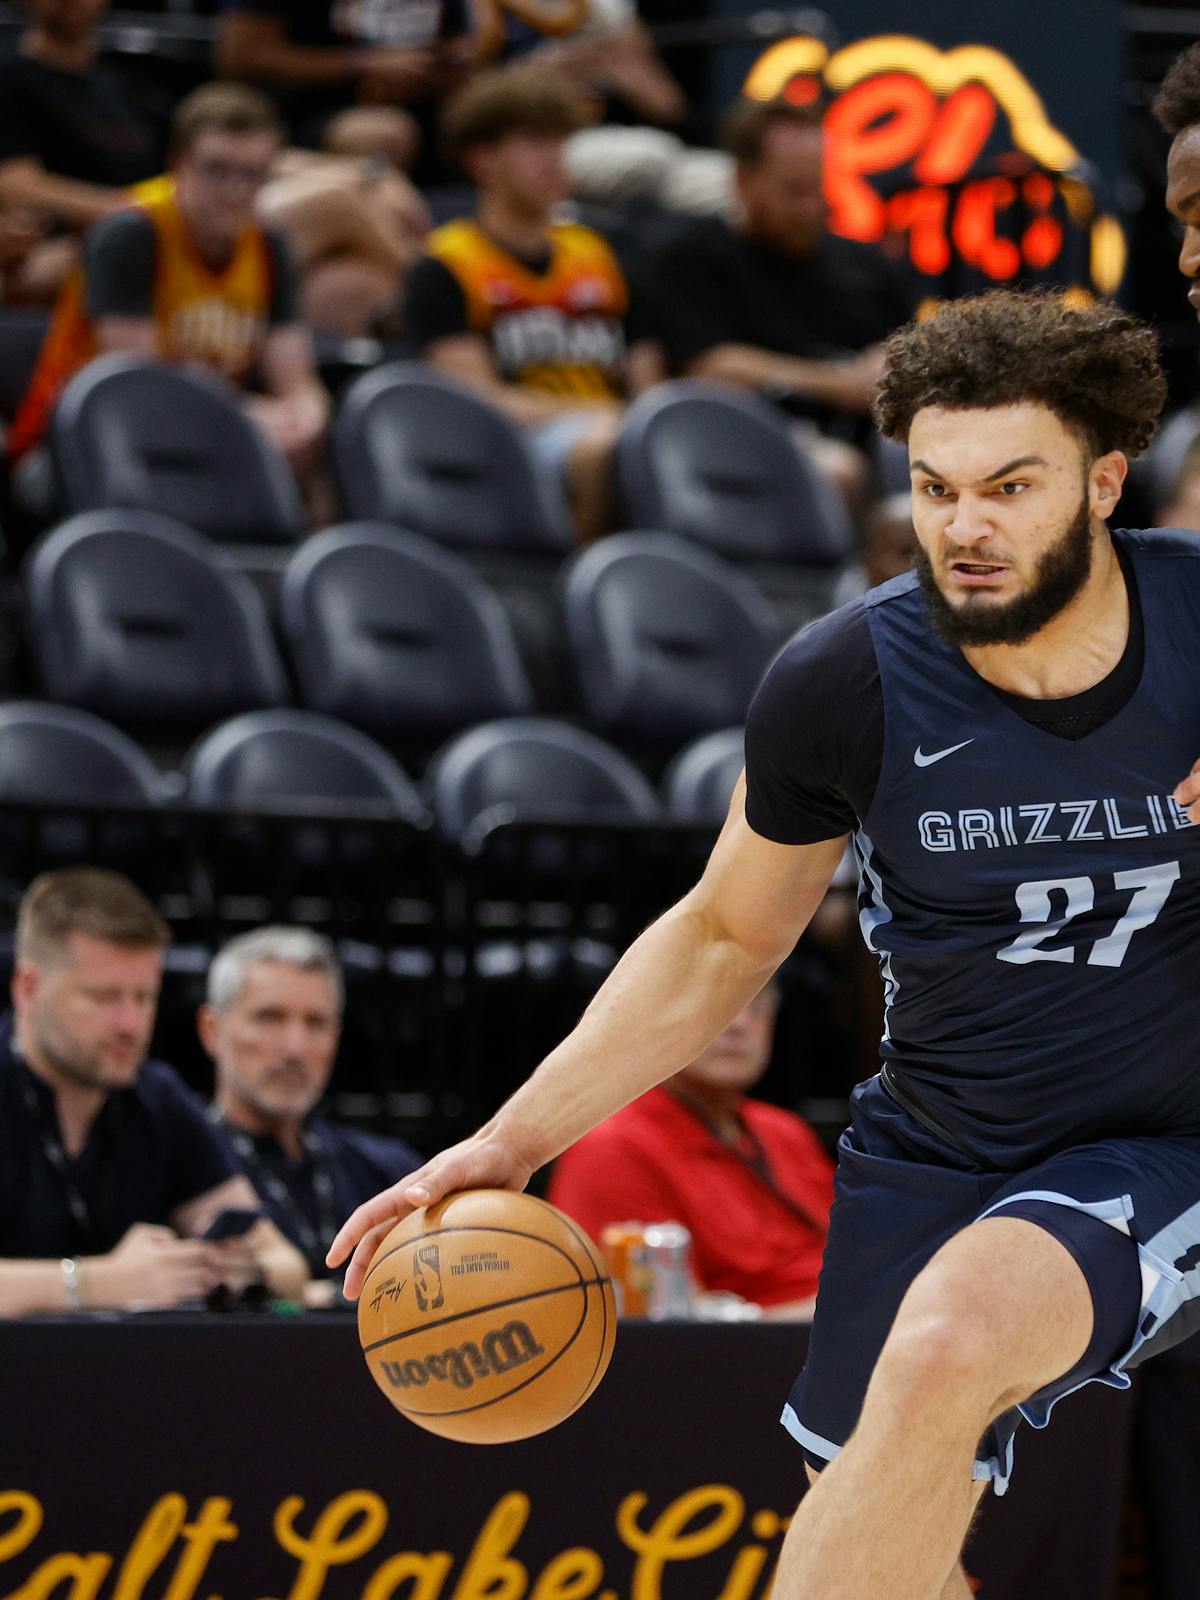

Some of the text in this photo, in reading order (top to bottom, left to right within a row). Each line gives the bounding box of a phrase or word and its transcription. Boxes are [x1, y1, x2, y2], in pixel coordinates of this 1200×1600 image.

[996, 860, 1181, 967] 27
[381, 1320, 546, 1389] Wilson
[272, 1489, 604, 1600] Lake
[614, 1484, 795, 1600] Ci
